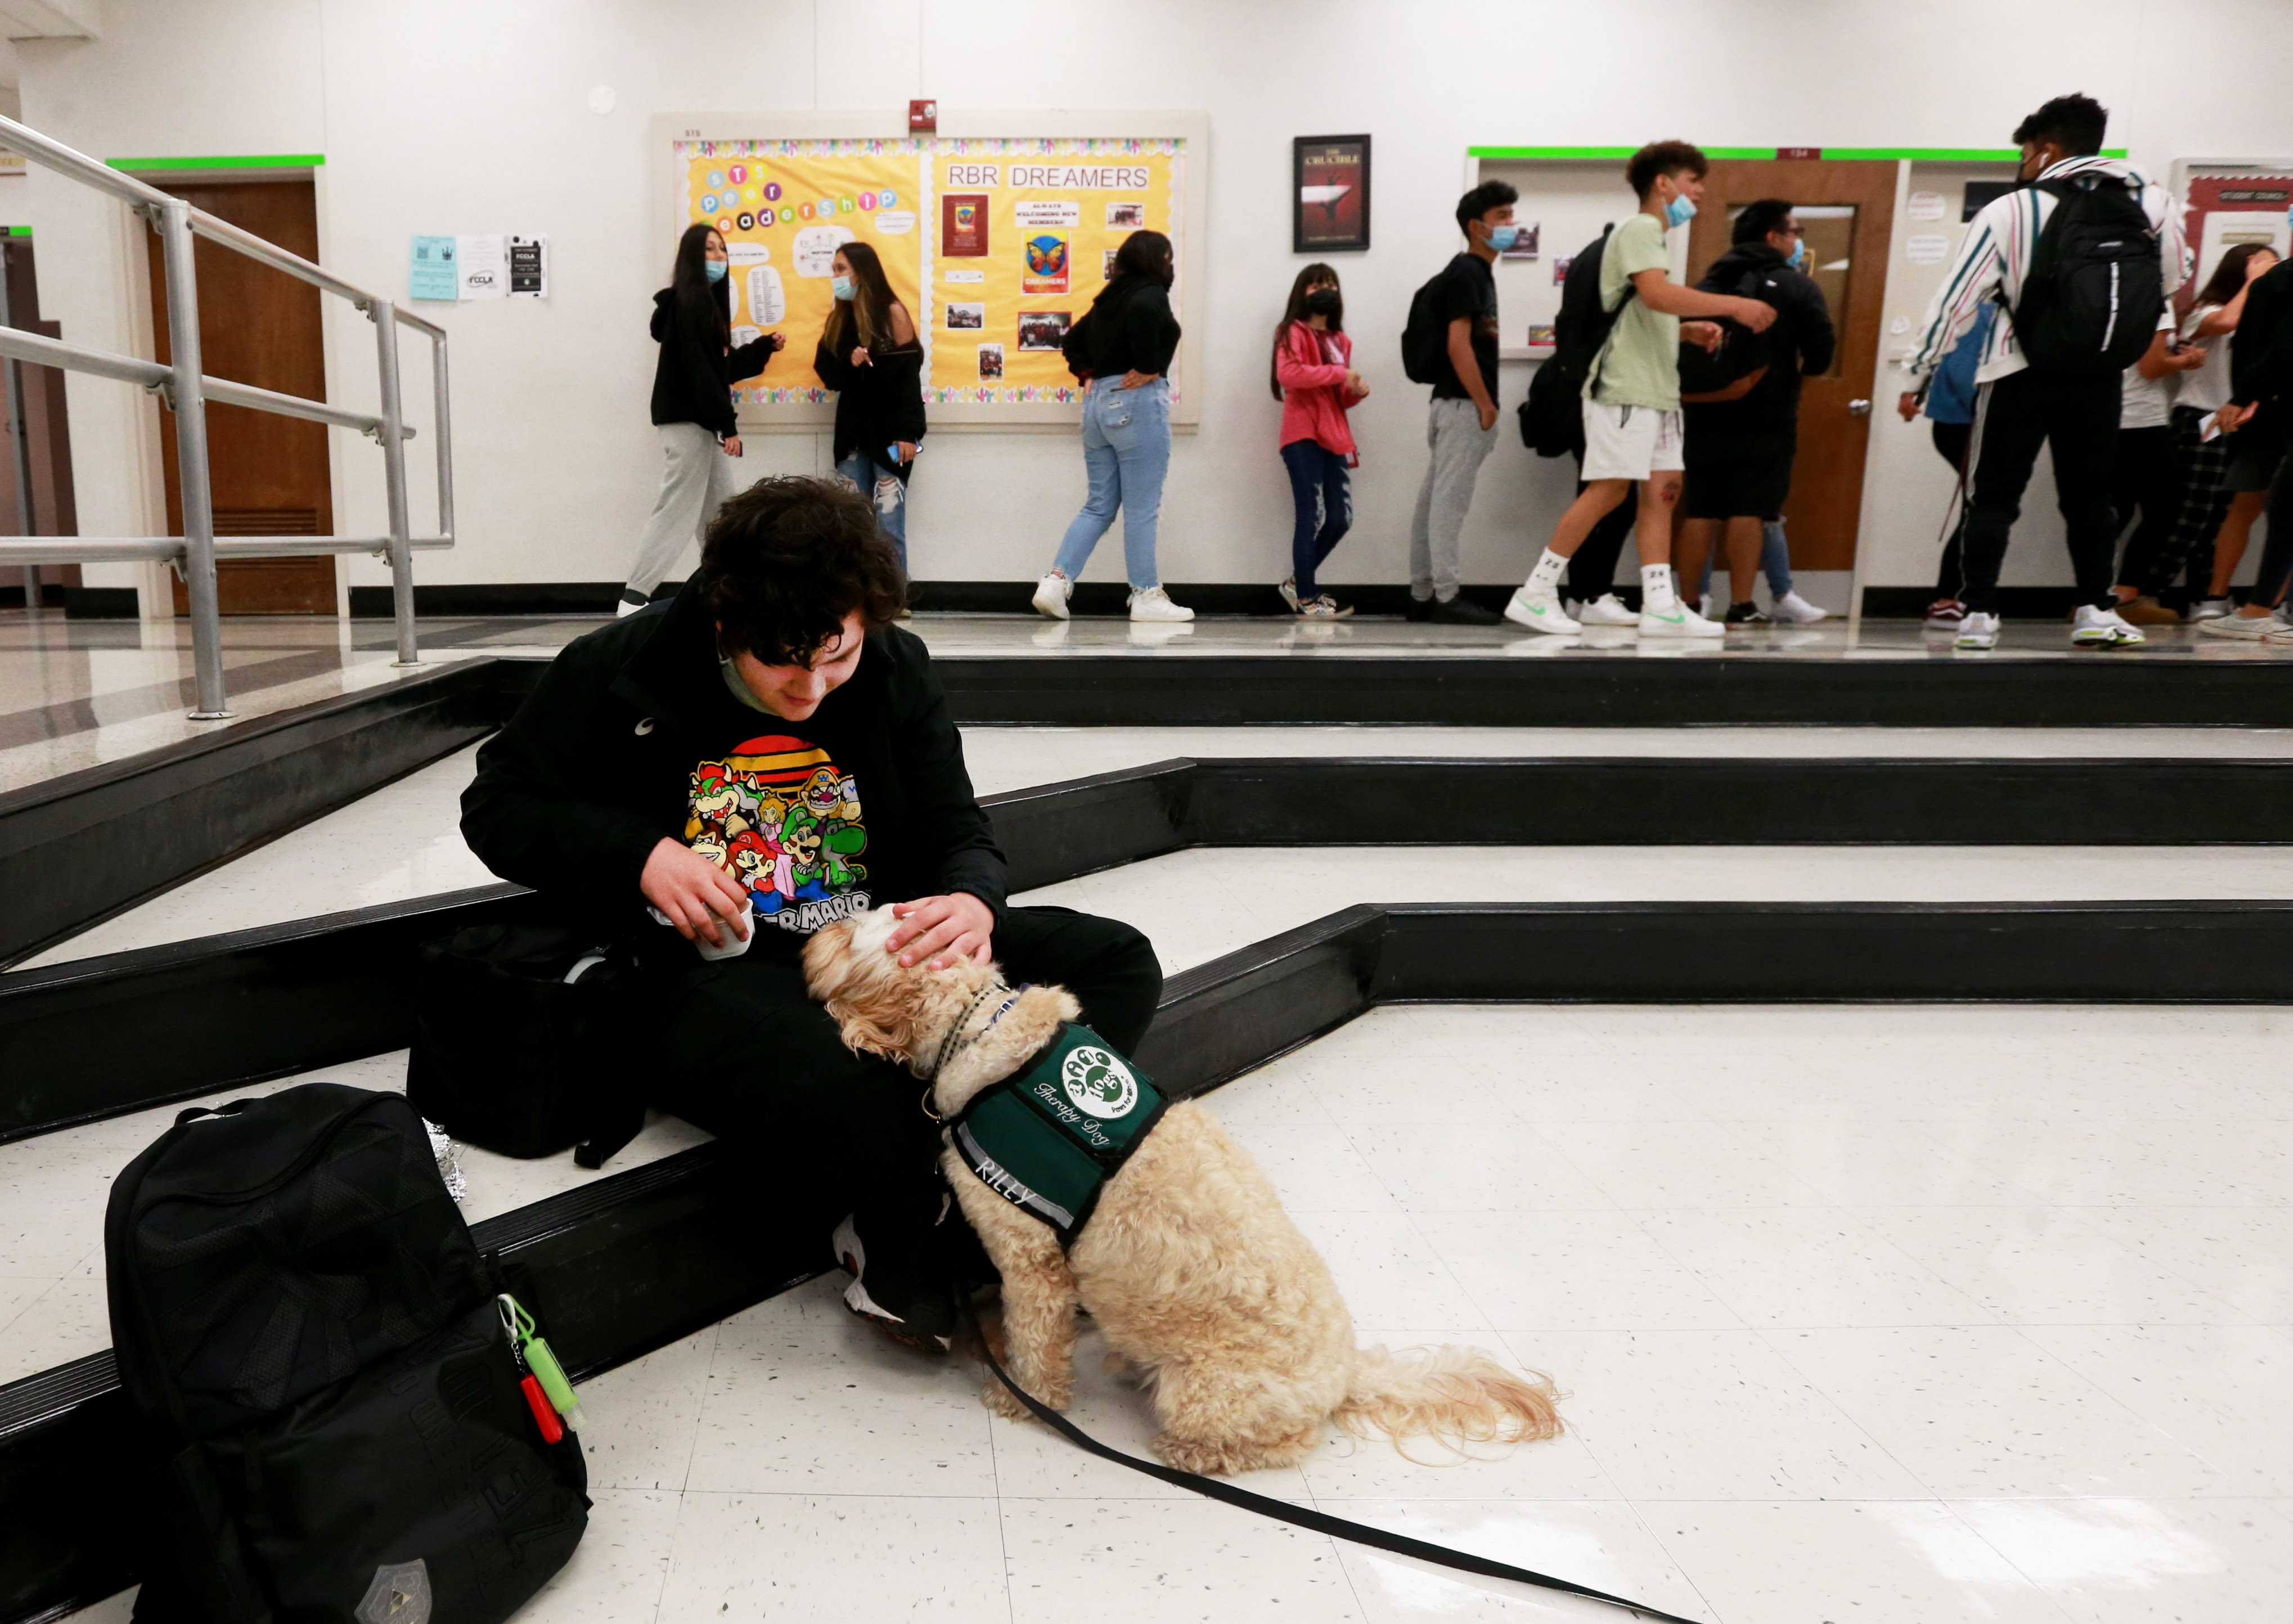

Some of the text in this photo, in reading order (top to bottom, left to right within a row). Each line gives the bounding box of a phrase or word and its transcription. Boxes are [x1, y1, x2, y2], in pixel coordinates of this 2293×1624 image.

[949, 166, 1148, 187] RBR DREAMERS
[799, 892, 870, 930] MARIO
[1033, 1082, 1110, 1146] Therapy Dog
[975, 1157, 1037, 1205] RILEY
